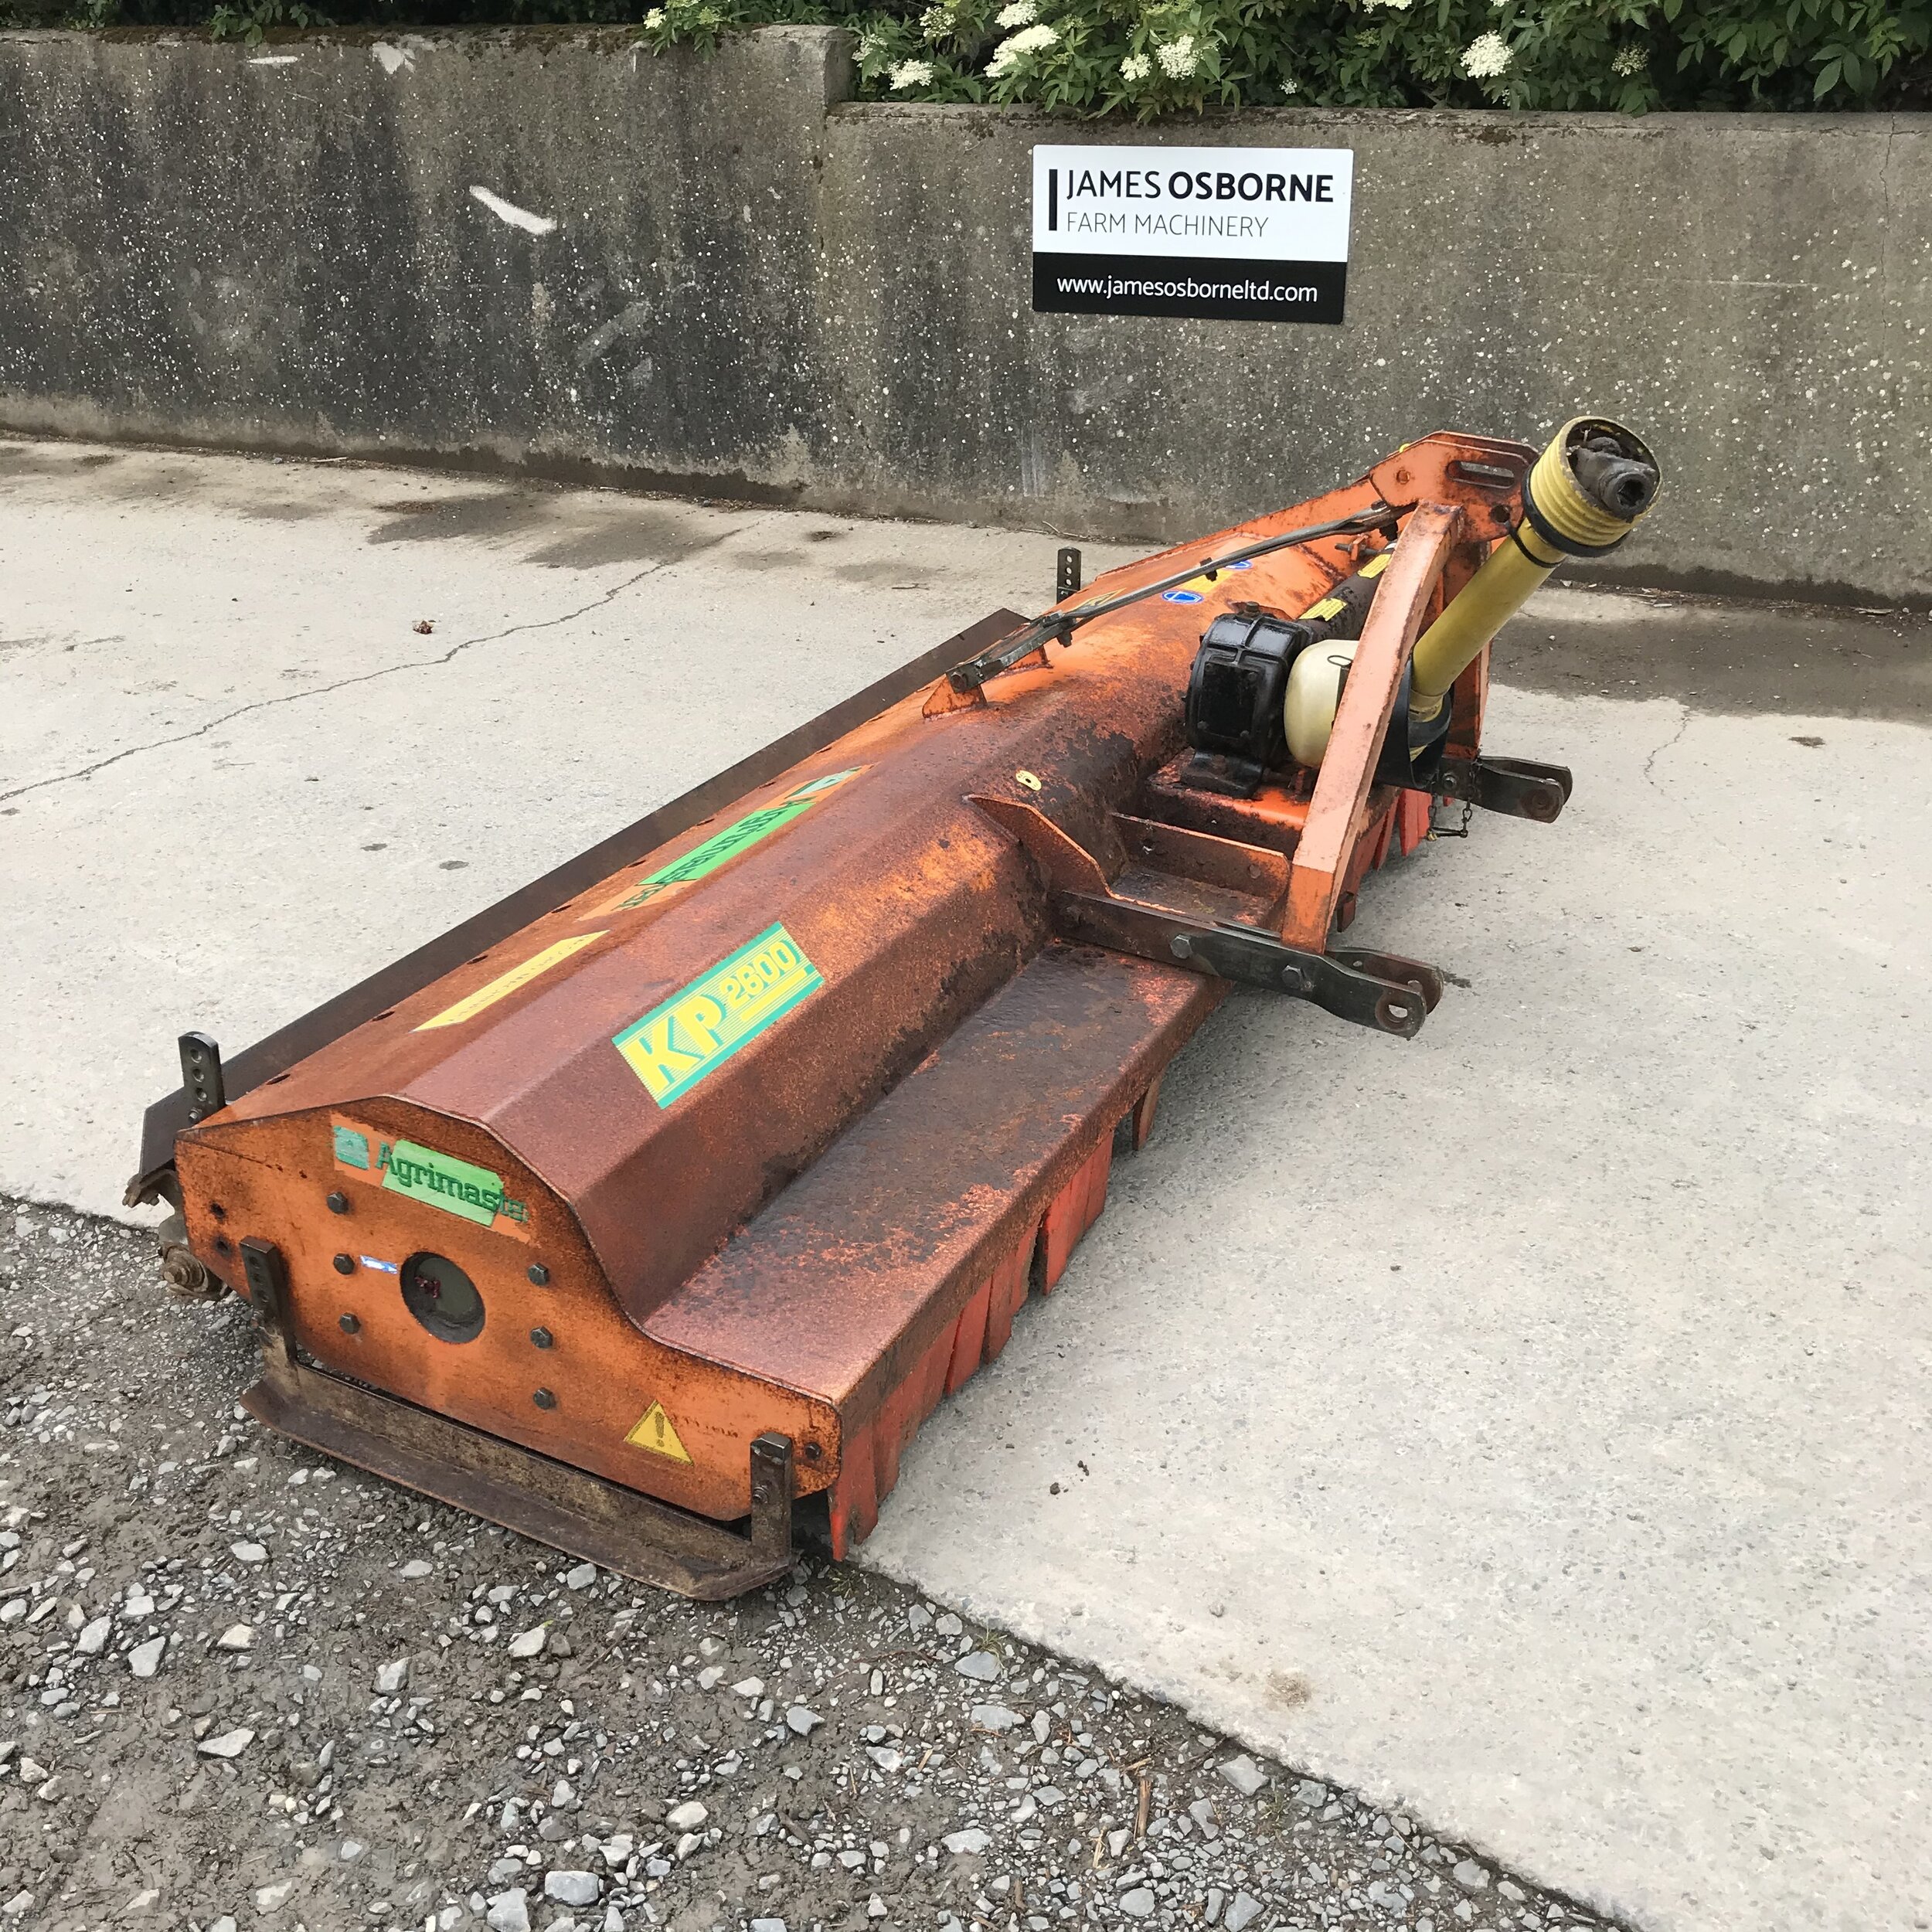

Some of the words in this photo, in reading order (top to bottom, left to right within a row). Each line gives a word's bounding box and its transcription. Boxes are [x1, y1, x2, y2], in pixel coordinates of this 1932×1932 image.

[1066, 169, 1161, 200] JAMES
[1168, 171, 1334, 202] OSBORNE
[1067, 212, 1126, 233] FARM
[1134, 214, 1269, 237] MACHINERY
[1056, 275, 1318, 302] www.jamesosborneltd.com
[627, 994, 725, 1092] KP
